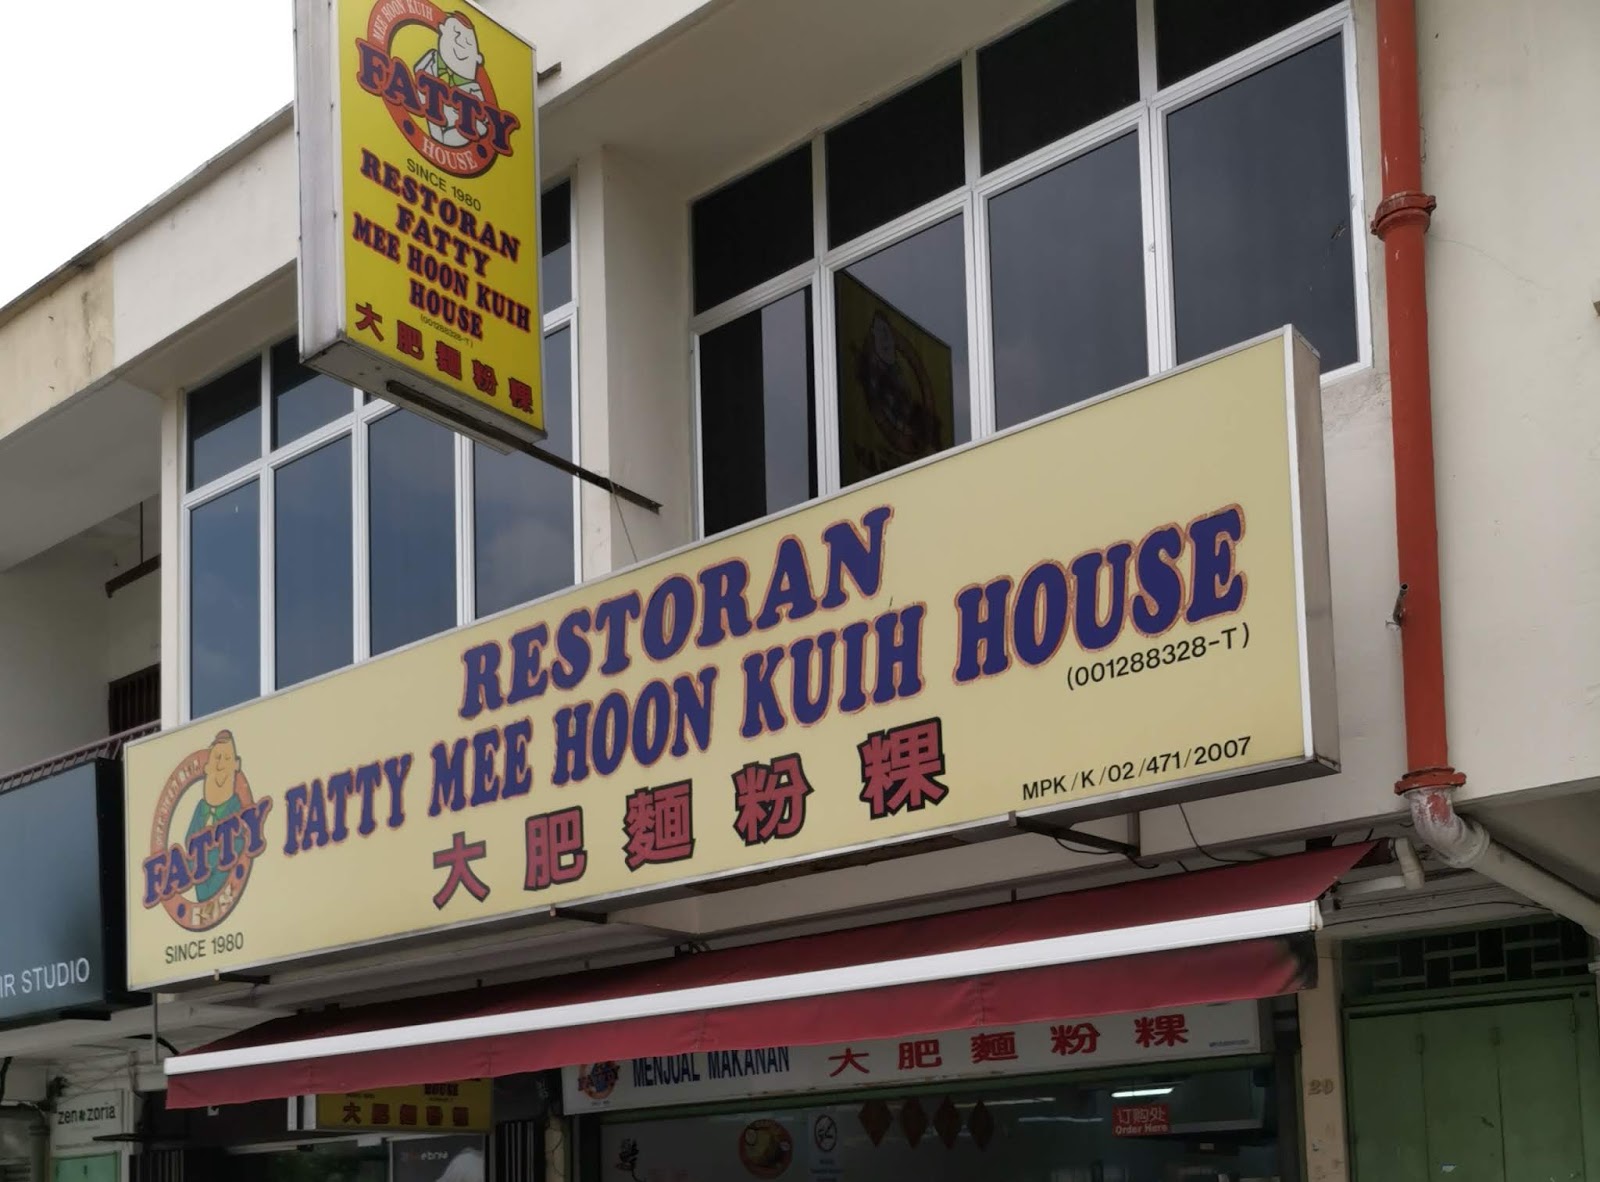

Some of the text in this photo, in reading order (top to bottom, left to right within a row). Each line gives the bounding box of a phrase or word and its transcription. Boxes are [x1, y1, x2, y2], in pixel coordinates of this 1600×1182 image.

[355, 38, 520, 157] FATTY
[406, 158, 482, 212] SINCE 1980
[421, 136, 478, 170] HOUSE
[361, 147, 521, 264] RESTORAN
[396, 203, 491, 277] FATTY
[353, 211, 531, 333] MEE HOON KUIH
[409, 277, 483, 340] HOUSE
[459, 504, 894, 719] RESTORAN
[282, 752, 413, 856] FATTY
[427, 716, 533, 817] MEE
[551, 664, 719, 787] HOON
[740, 601, 926, 738] KUIH
[952, 502, 1248, 685] HOUSE
[1067, 622, 1249, 690] (001288328-T)
[143, 795, 273, 909] FATTY
[21, 957, 89, 994] STUDIO
[165, 932, 244, 964] SINCE 1980
[633, 1053, 700, 1087] MENJUAL
[708, 1046, 790, 1079] MAKANAN
